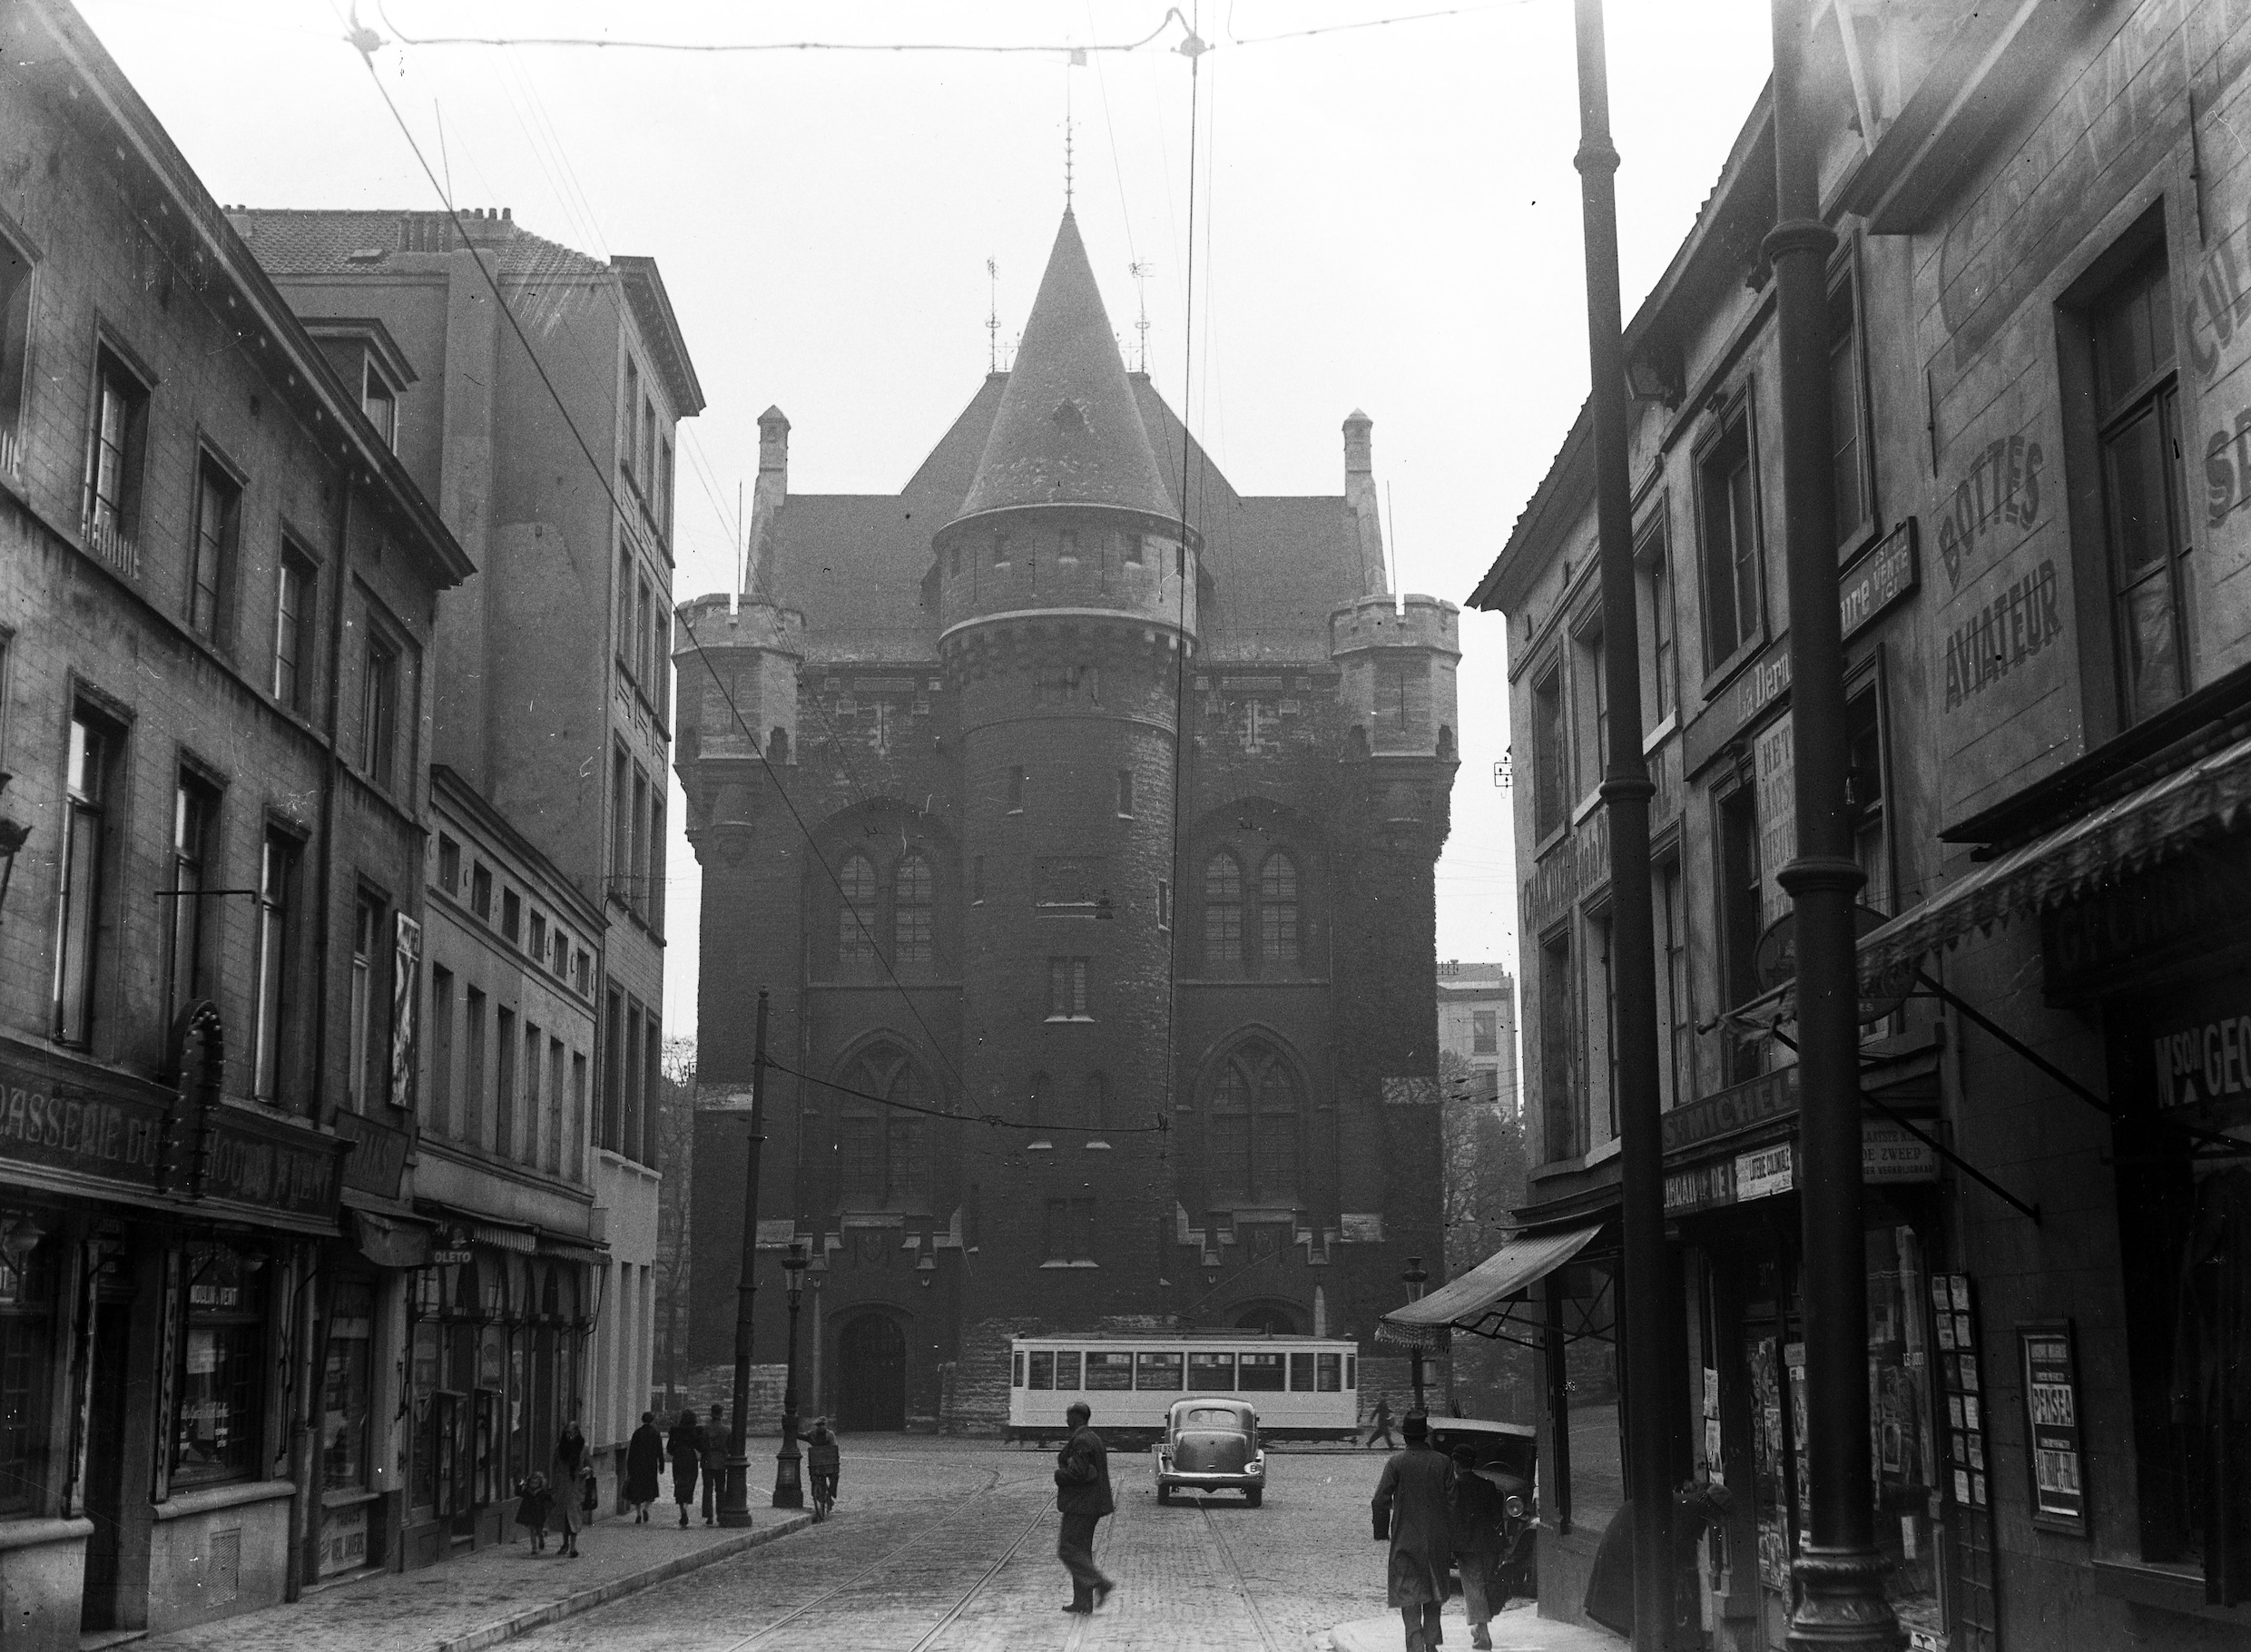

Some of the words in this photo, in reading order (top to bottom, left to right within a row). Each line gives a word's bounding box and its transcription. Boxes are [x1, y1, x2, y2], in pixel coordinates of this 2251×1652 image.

[1938, 435, 2043, 592] BOTTES
[1945, 559, 2061, 713] AVIATEUR
[1762, 727, 1792, 775] HET
[1686, 1077, 1792, 1140] MICHEL
[1664, 1170, 1708, 1208] IBRAIRIE
